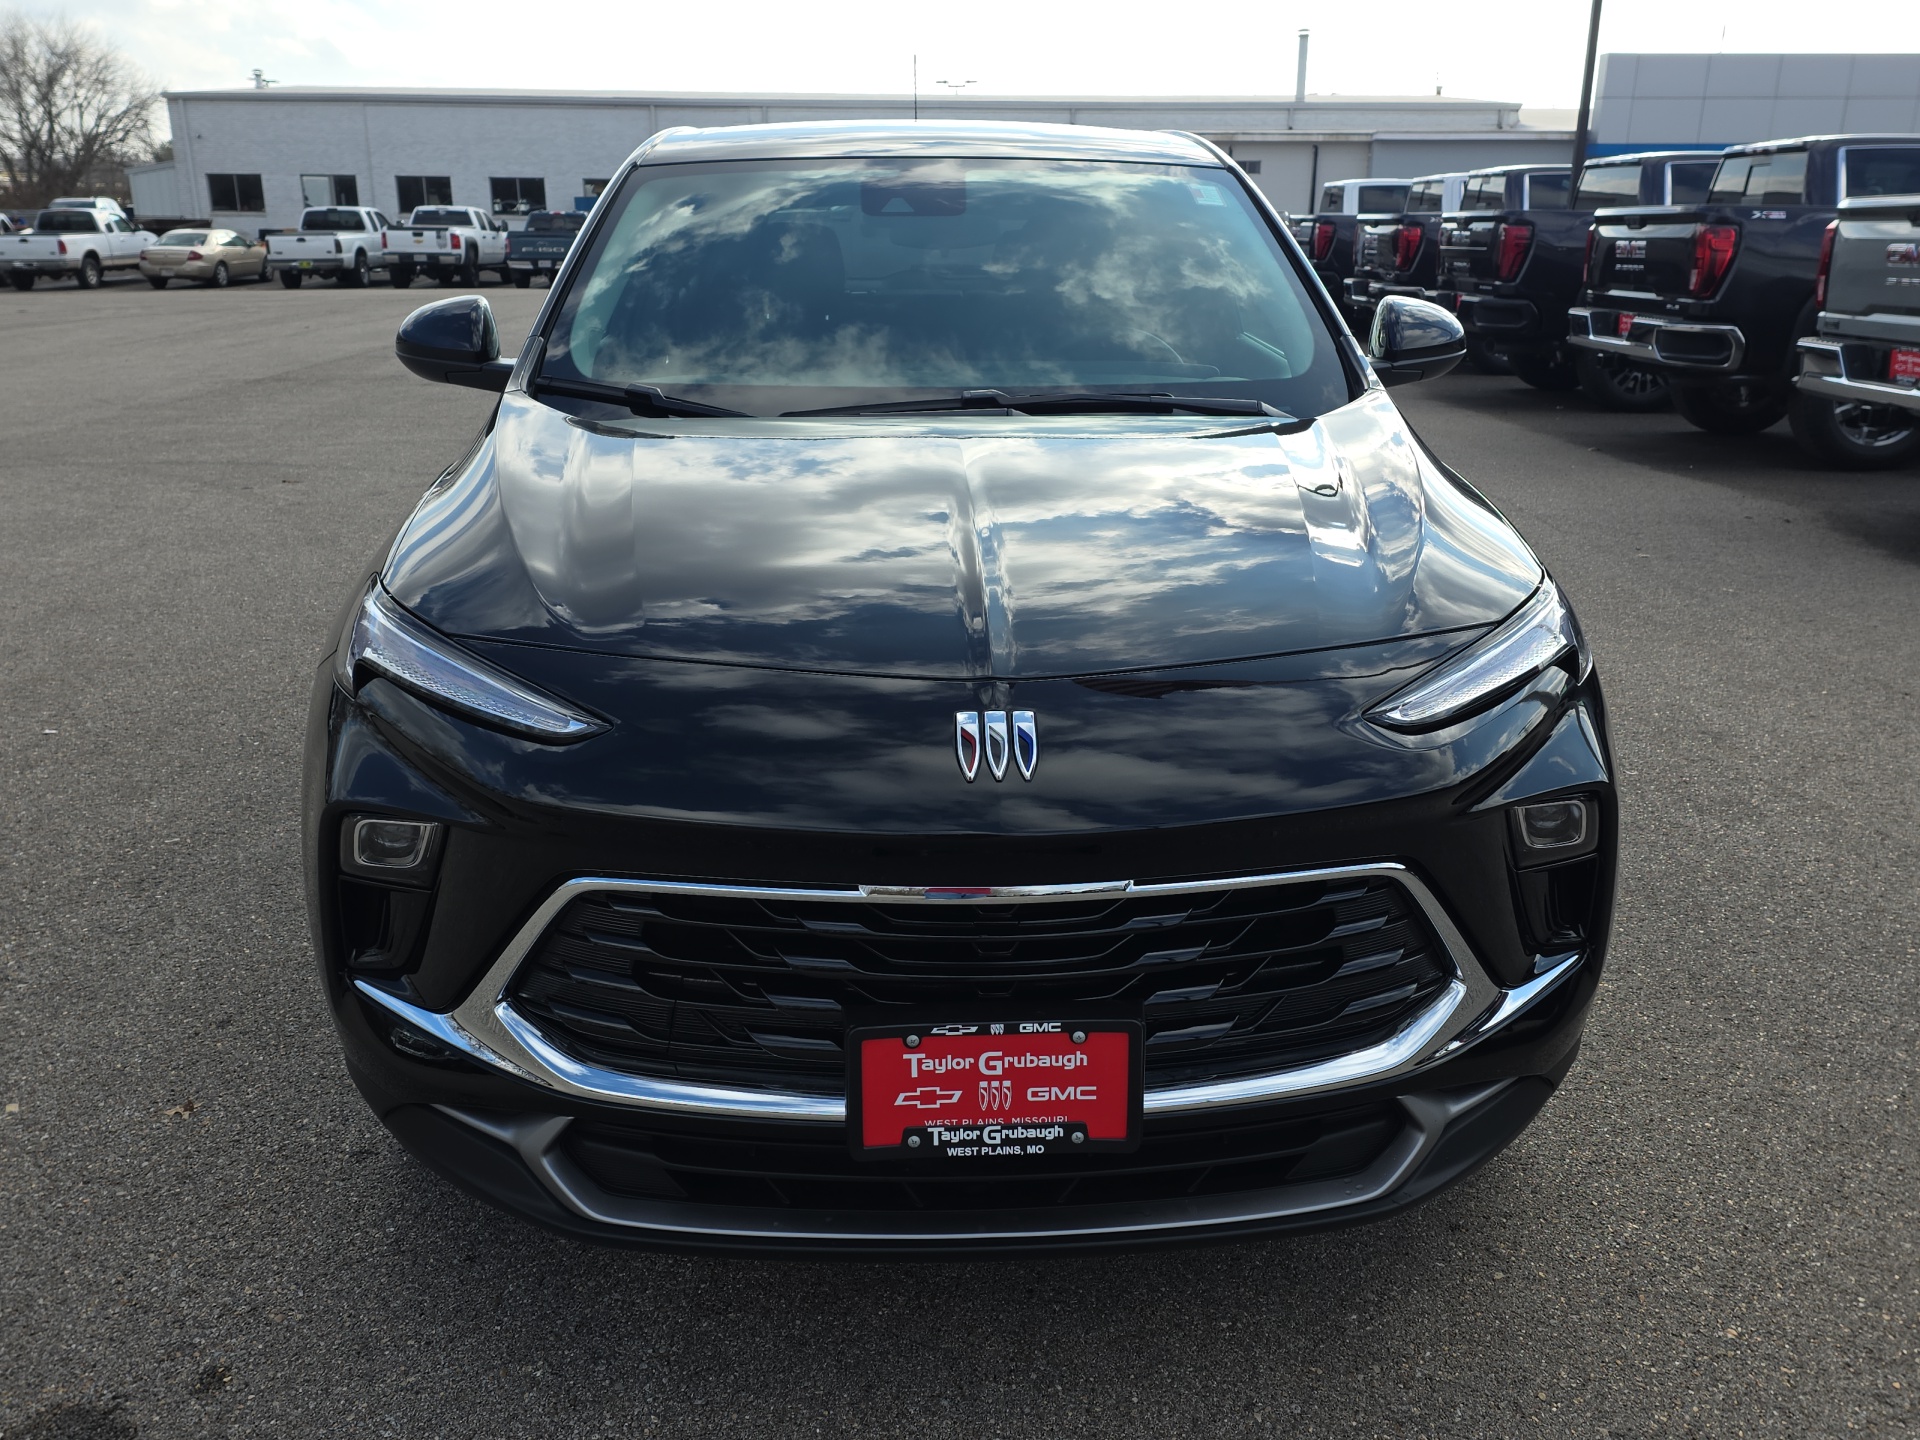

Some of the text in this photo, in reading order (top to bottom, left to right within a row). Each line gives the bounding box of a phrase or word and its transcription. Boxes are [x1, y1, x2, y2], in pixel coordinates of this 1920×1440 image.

[1019, 1022, 1062, 1033] GMC
[902, 1050, 1088, 1078] Taylor Grubaugh
[1026, 1086, 1097, 1101] GMC
[927, 1125, 1064, 1146] Taylor Grubaugh
[946, 1145, 1045, 1157] WEST PLAINS, MO
